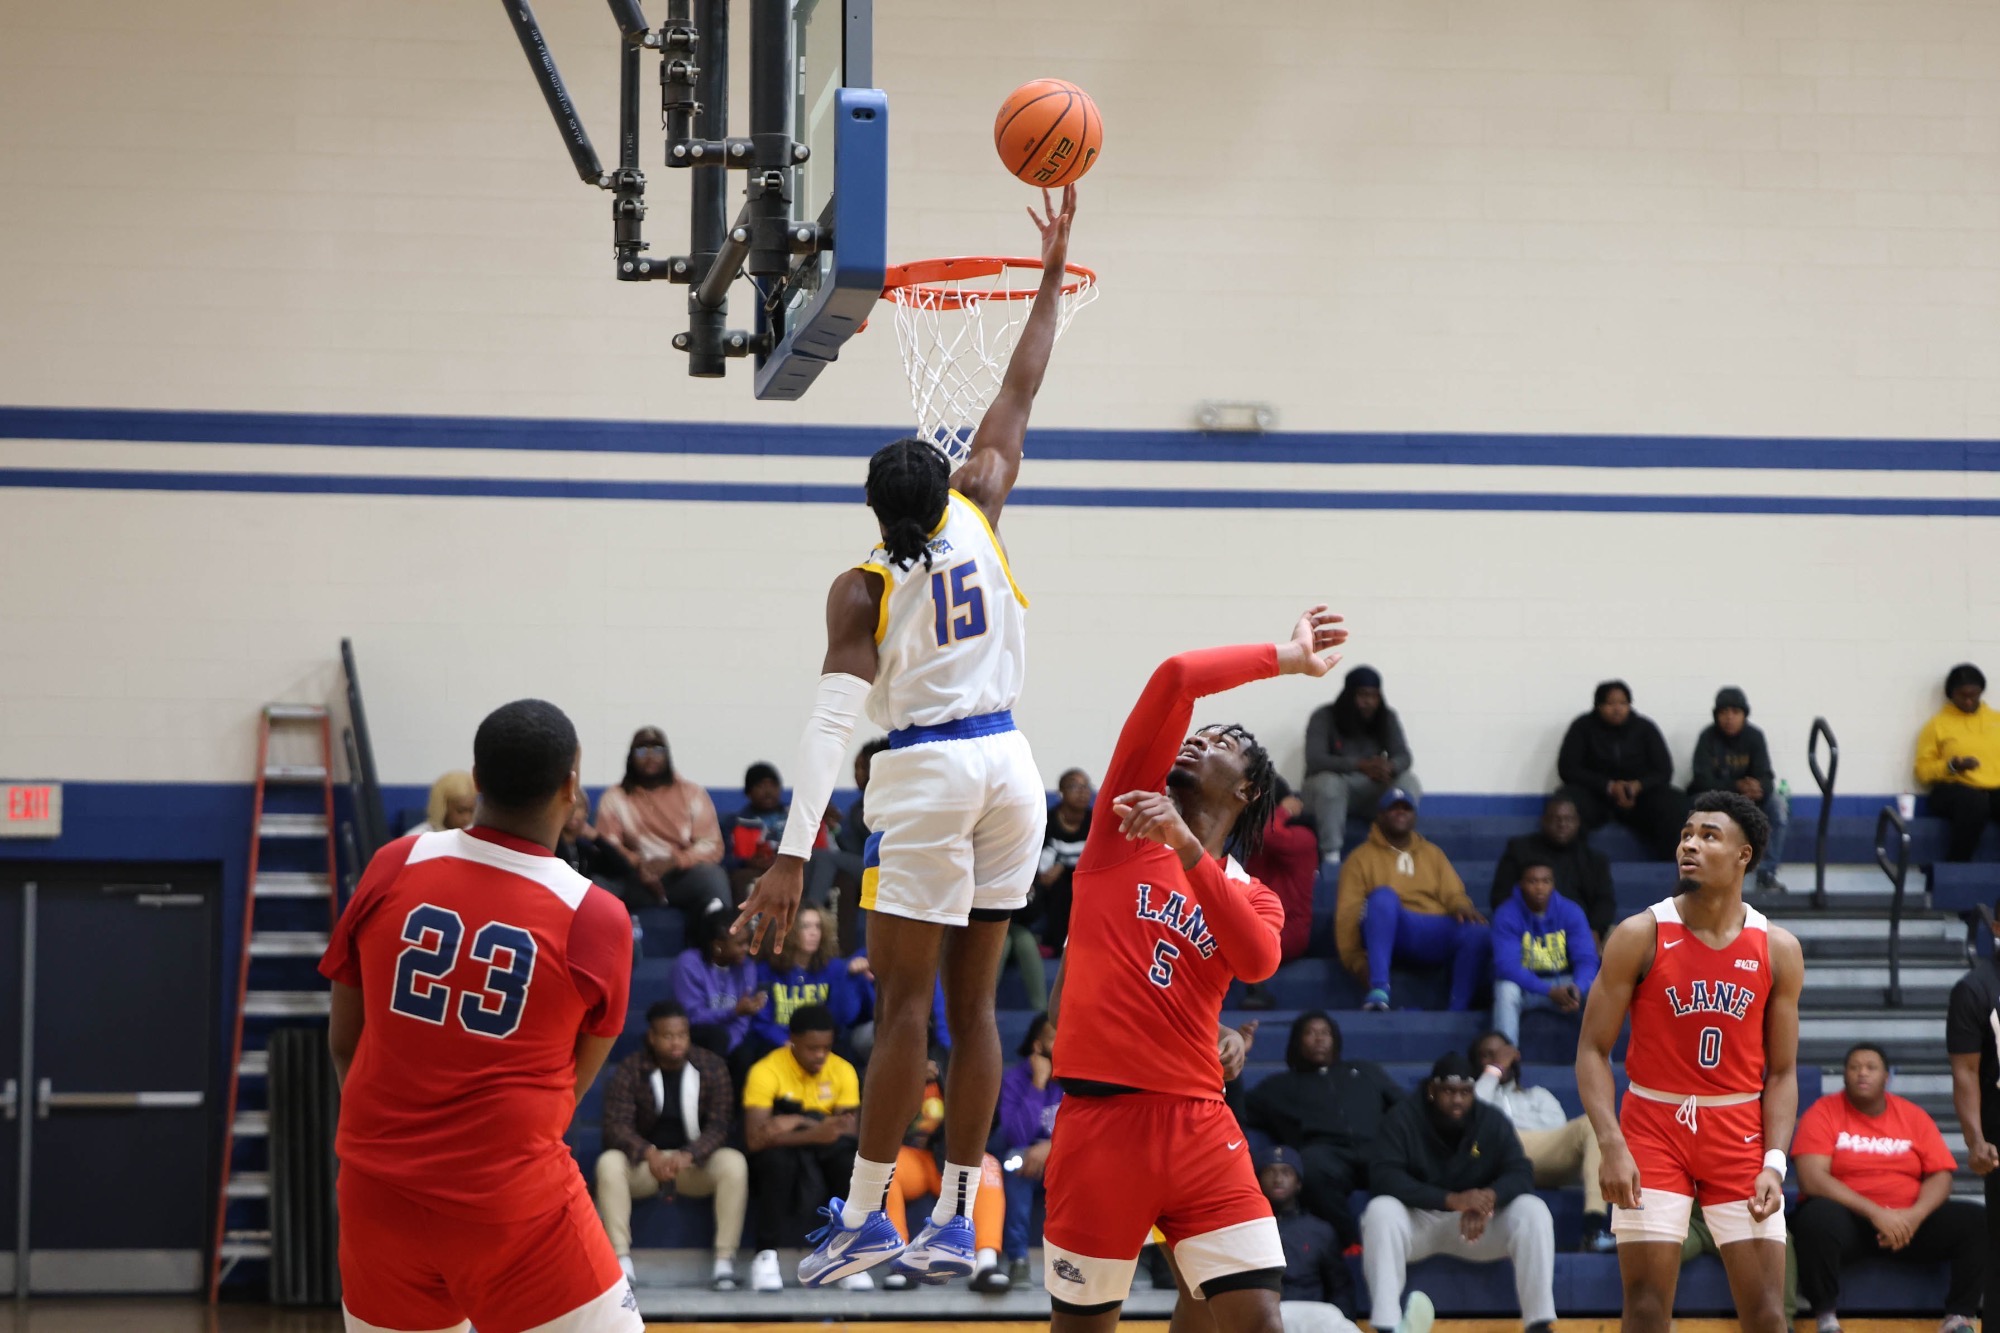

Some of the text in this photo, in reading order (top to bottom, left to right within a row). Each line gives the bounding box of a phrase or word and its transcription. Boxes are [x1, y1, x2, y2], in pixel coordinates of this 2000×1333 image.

[568, 117, 584, 145] ALLEN
[1033, 137, 1075, 182] ELITE
[930, 557, 989, 649] 15
[8, 786, 51, 821] EXIT
[1136, 883, 1218, 960] LANE
[389, 902, 538, 1040] 23
[1148, 938, 1180, 988] 5
[1665, 980, 1755, 1021] LANE
[1698, 1026, 1723, 1068] 0
